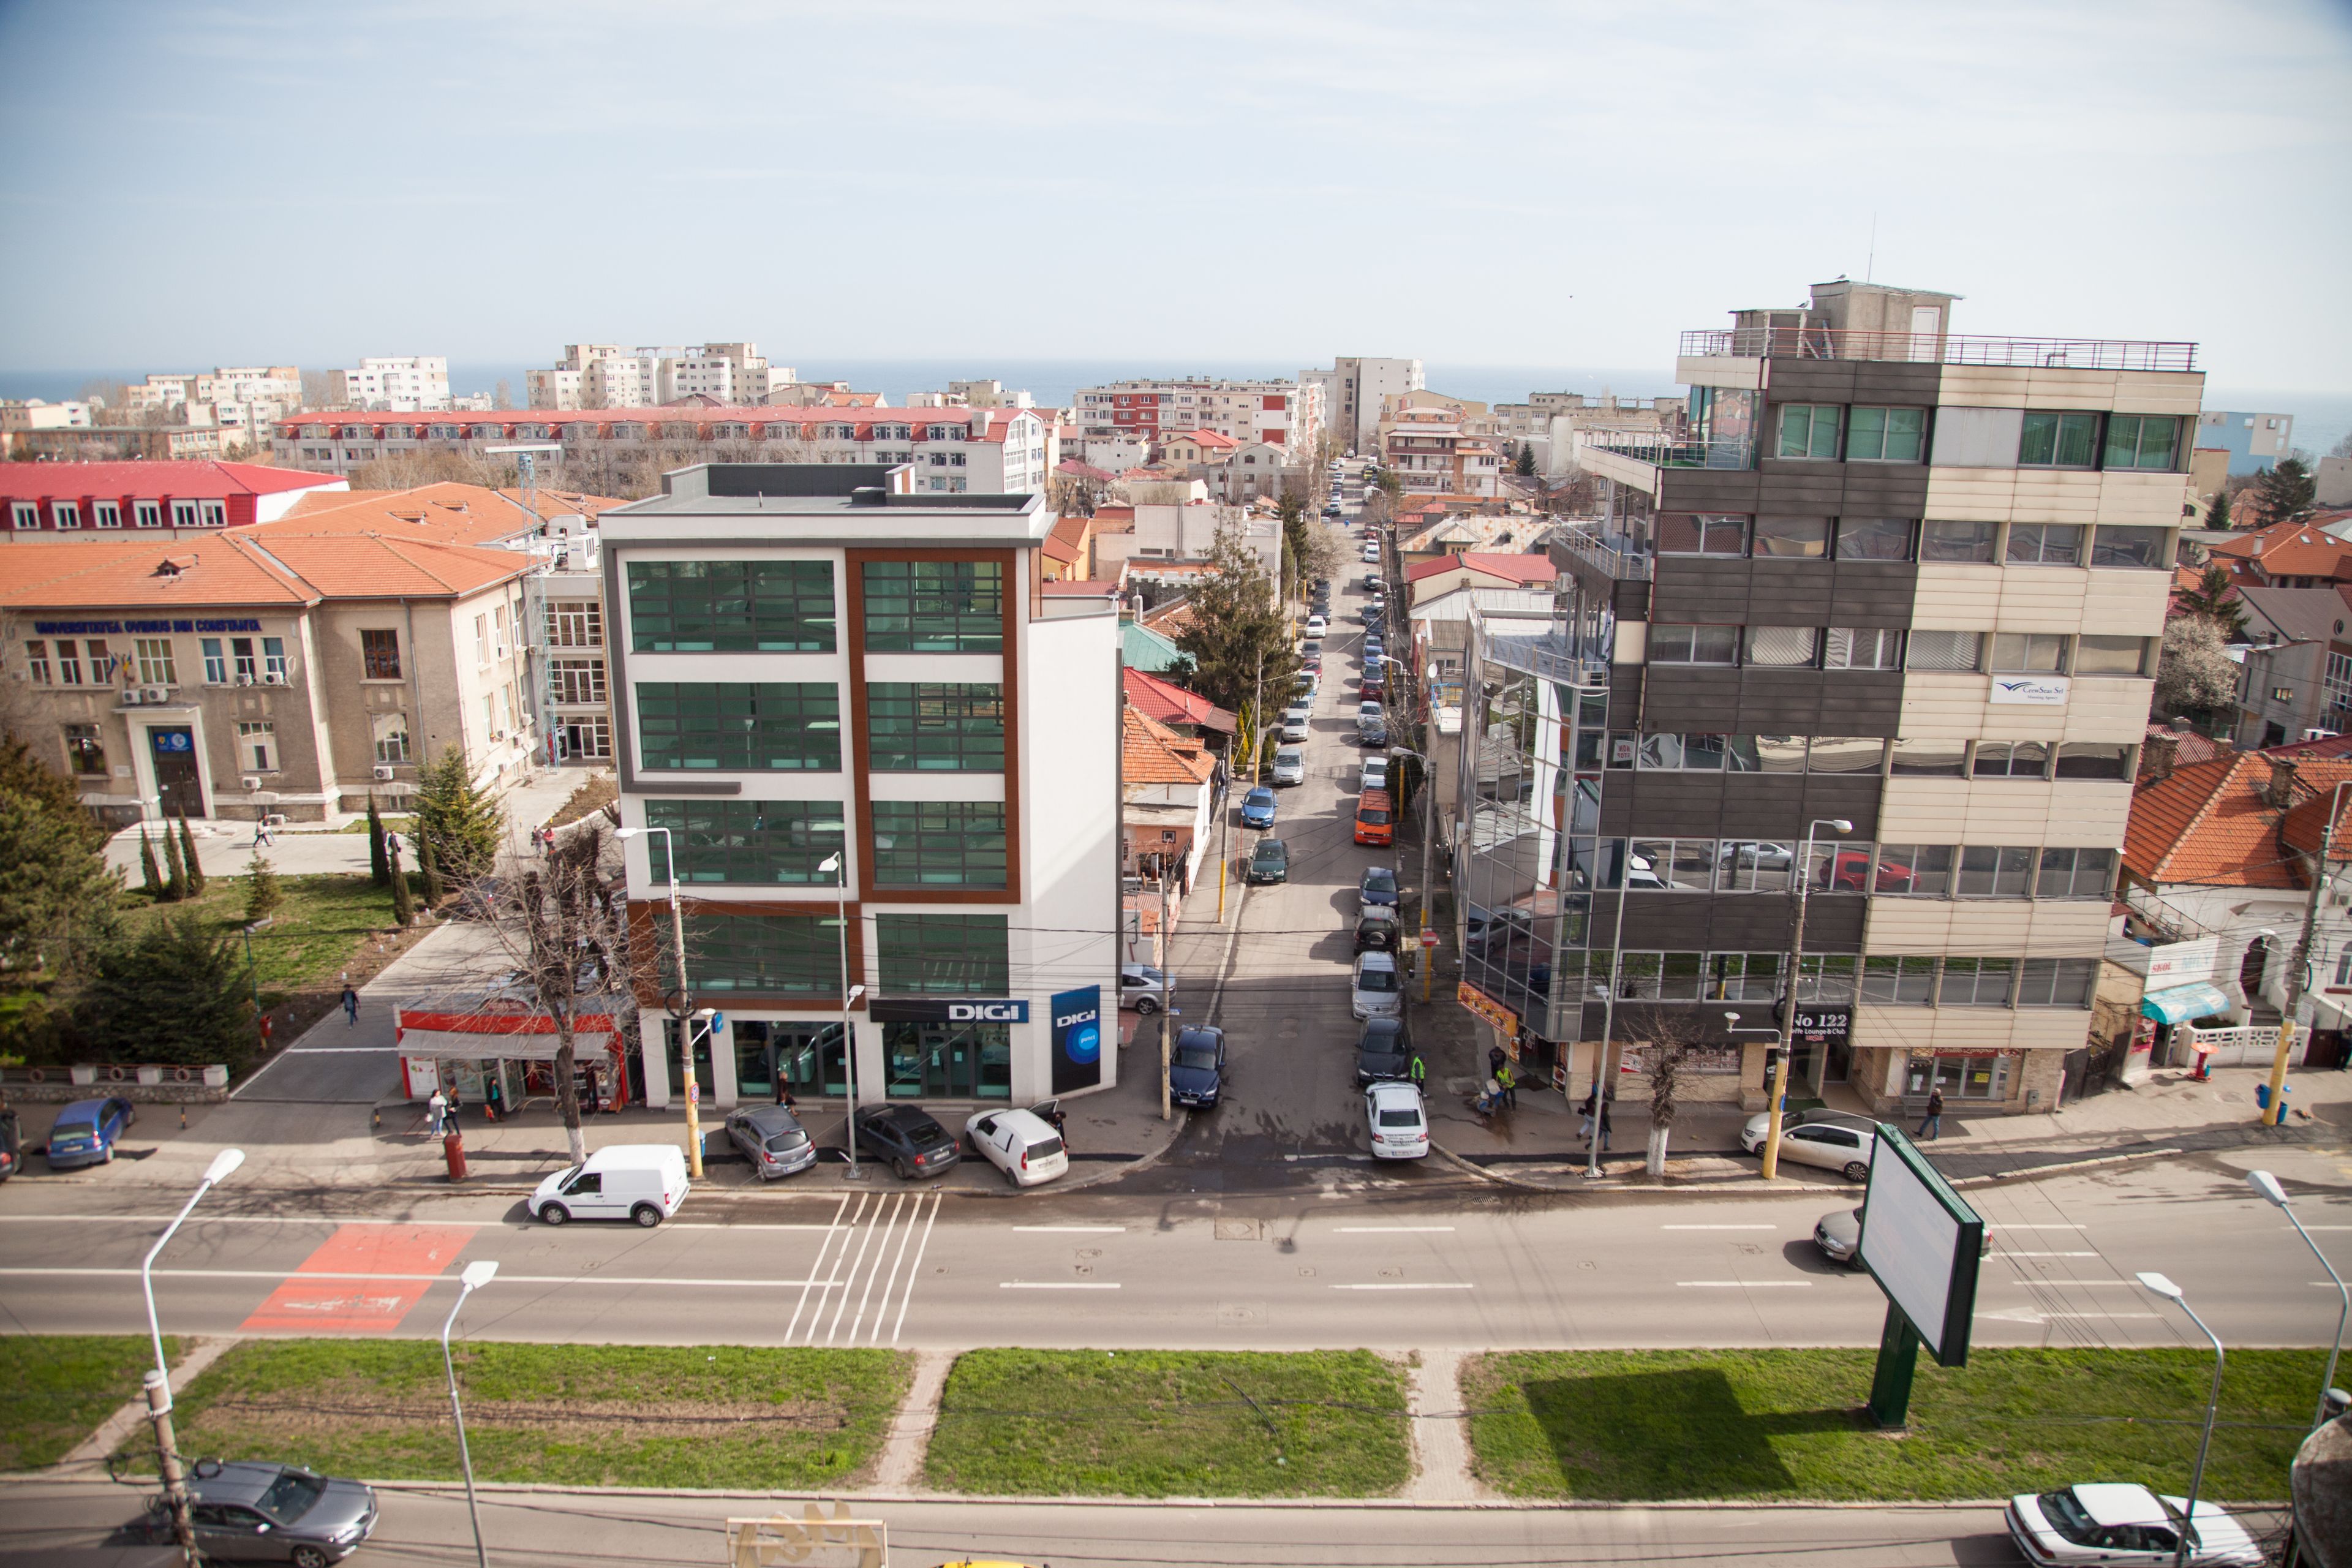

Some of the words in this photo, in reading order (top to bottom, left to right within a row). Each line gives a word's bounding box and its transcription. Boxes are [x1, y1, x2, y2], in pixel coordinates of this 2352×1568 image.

[35, 621, 123, 634] UNIVERSITATEA
[124, 620, 172, 633] OVIDIUS
[174, 620, 193, 632] DIN
[949, 1005, 1019, 1020] DIGI
[1057, 1009, 1096, 1028] DIGI
[1819, 1014, 1847, 1027] 122
[1080, 1035, 1096, 1044] punct
